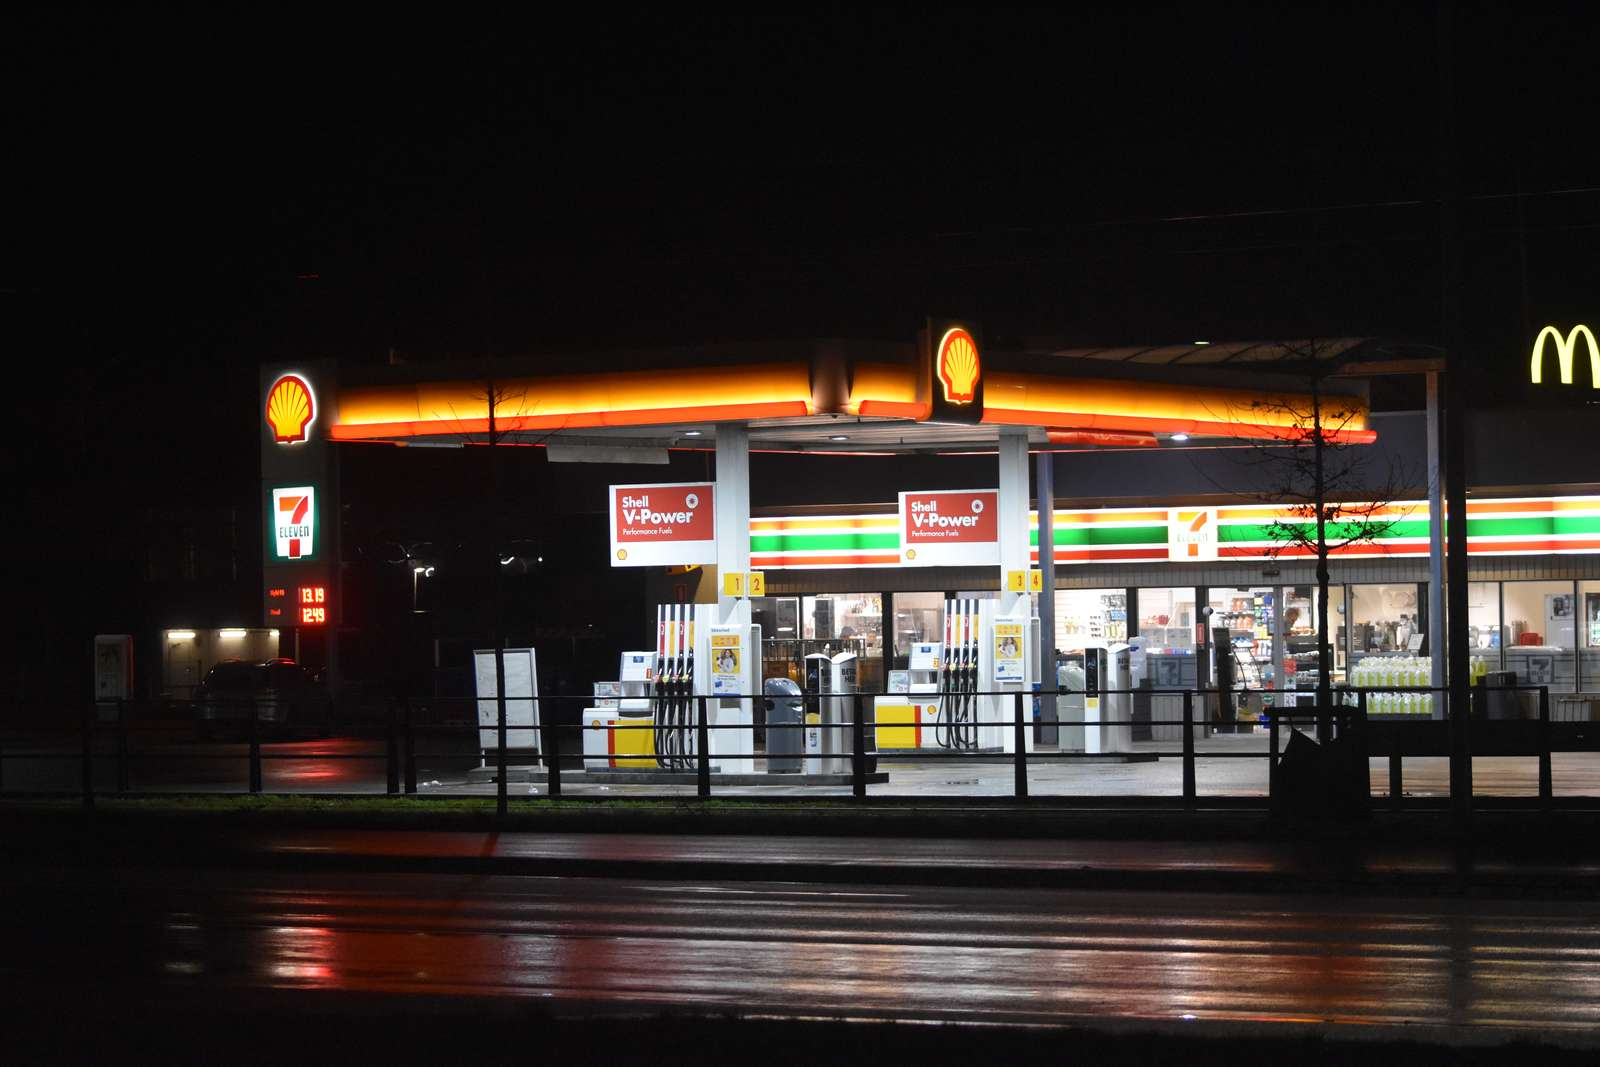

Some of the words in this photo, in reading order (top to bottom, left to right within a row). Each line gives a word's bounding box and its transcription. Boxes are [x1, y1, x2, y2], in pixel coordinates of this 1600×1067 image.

[622, 495, 649, 508] Shell
[911, 500, 936, 512] Shell
[622, 508, 693, 525] V-Power
[912, 513, 979, 528] V-Power
[279, 496, 309, 558] 7
[622, 527, 658, 536] Performance
[658, 526, 673, 535] Fuels
[911, 529, 945, 537] Performance
[945, 529, 960, 537] Fuels
[1177, 511, 1208, 557] 7
[735, 578, 740, 590] 1
[754, 577, 760, 591] 2
